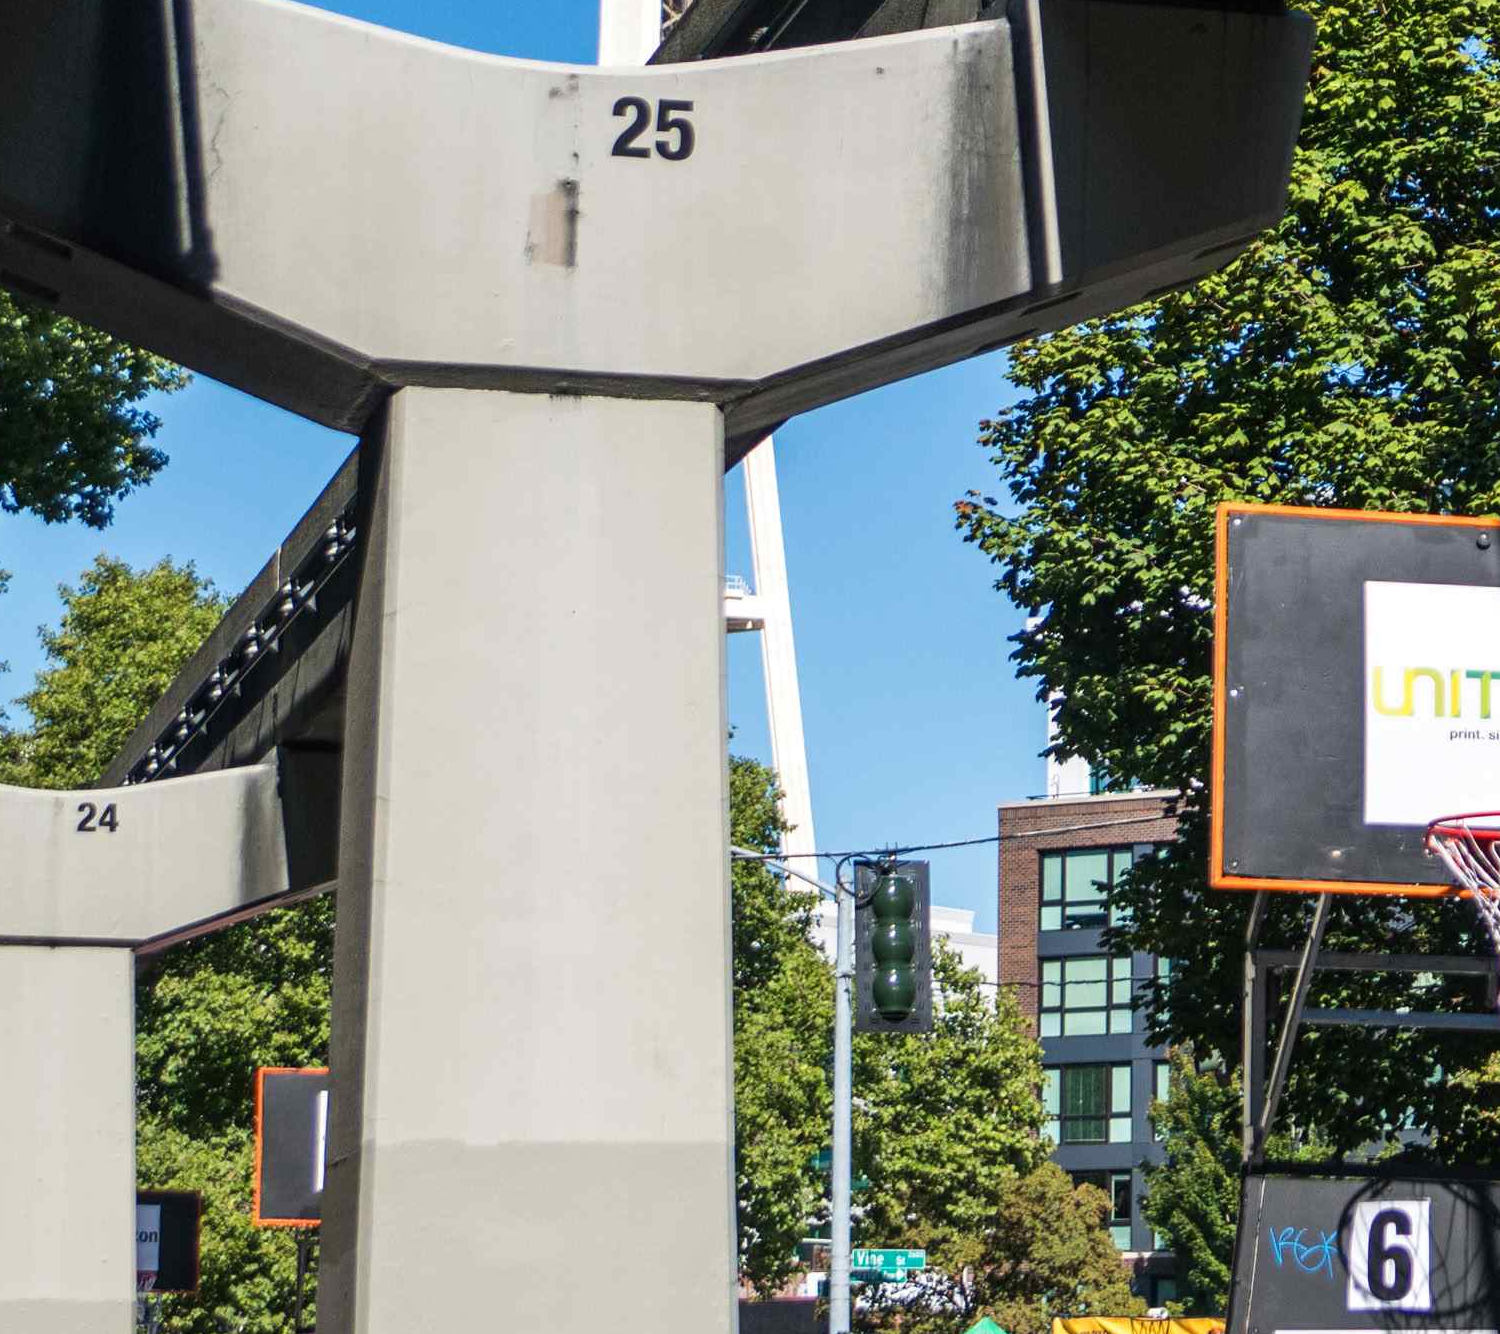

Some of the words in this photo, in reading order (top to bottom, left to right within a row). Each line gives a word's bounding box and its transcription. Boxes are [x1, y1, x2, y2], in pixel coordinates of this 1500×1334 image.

[611, 96, 695, 161] 25
[1449, 729, 1485, 742] print.
[76, 802, 120, 833] 24
[856, 1250, 885, 1266] Vine
[1367, 1207, 1413, 1301] 6
